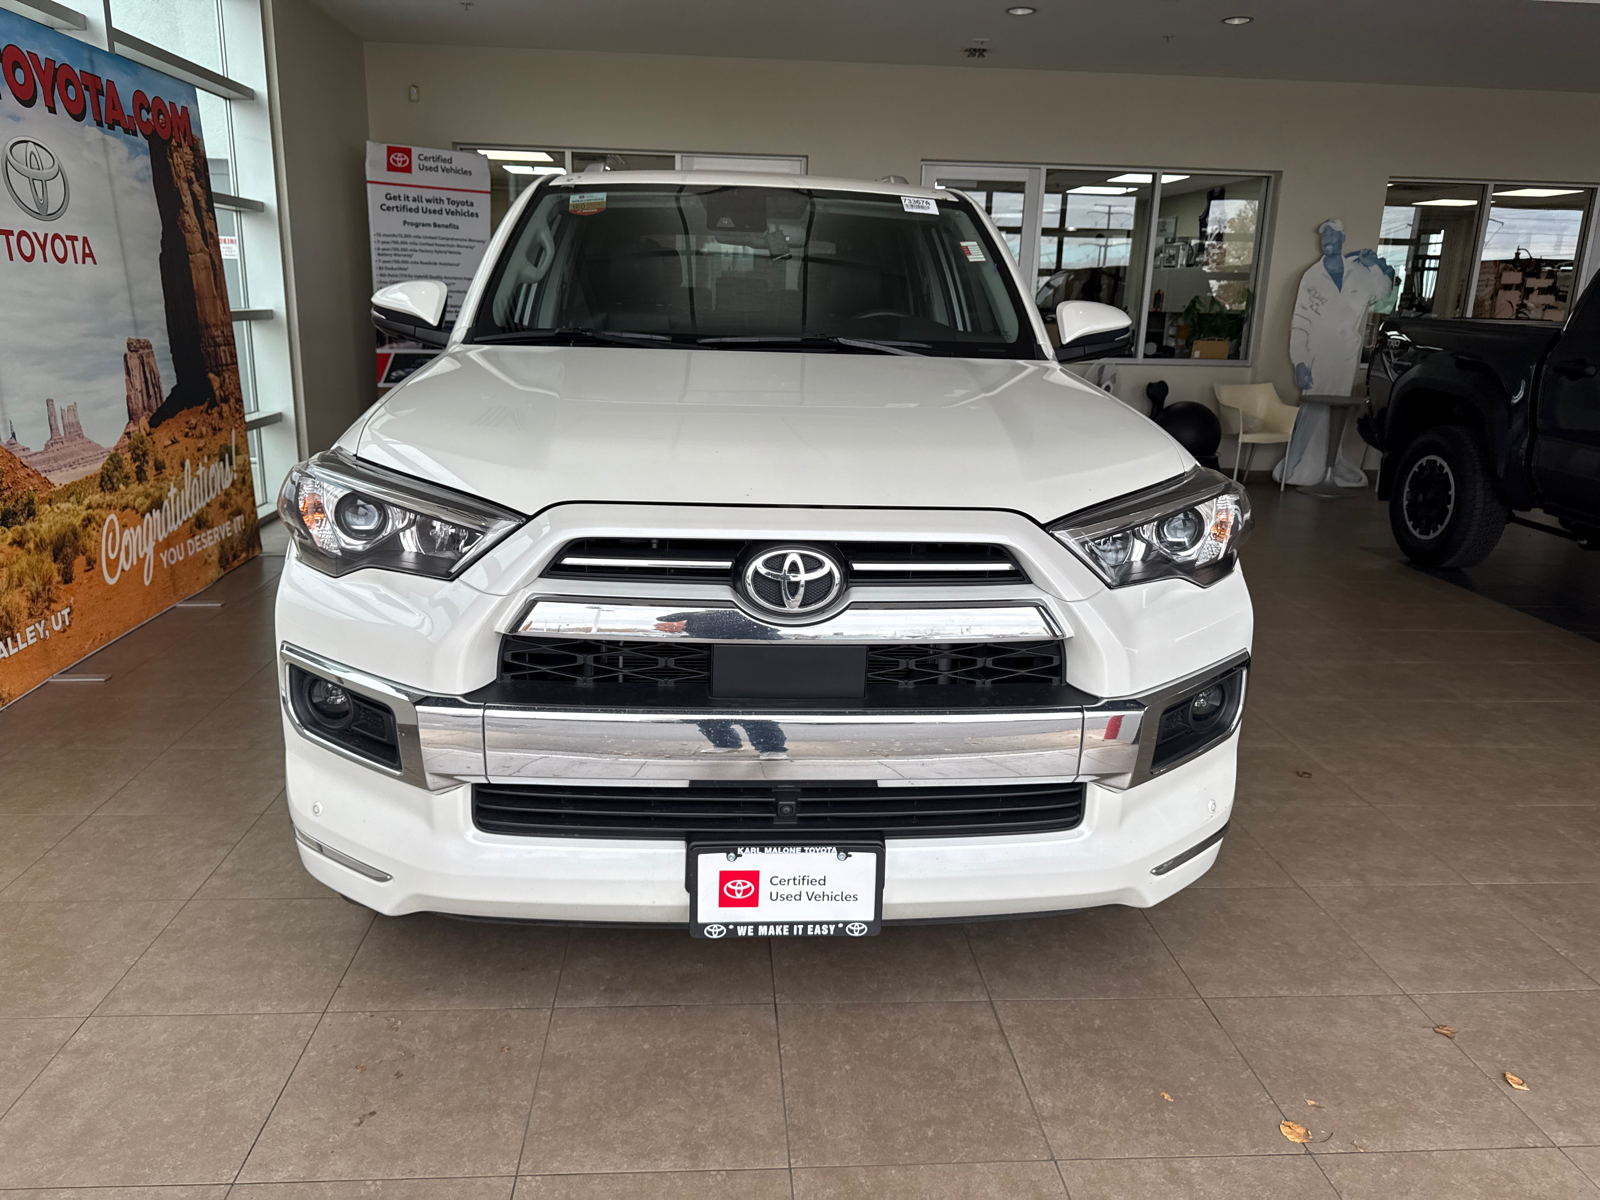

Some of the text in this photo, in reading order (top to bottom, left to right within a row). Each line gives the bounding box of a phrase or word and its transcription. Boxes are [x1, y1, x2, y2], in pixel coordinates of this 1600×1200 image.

[0, 44, 193, 147] OYOTA.COM
[418, 153, 453, 165] Certified
[418, 164, 472, 176] Used Vehicles
[385, 193, 474, 208] Get it all with Toyota
[380, 203, 479, 218] Certified Used Vehicles
[403, 220, 459, 230] Program Benefits
[0, 228, 97, 265] TOYOTA
[102, 428, 237, 586] Congratulations!
[160, 514, 245, 569] YOU DESERVE IT!
[51, 607, 71, 631] UT
[737, 847, 838, 855] KARL MALONE TOYOTA
[769, 875, 826, 886] Certified
[769, 891, 859, 902] Used Vehicles
[737, 925, 836, 936] WE MAKE IT EASY
